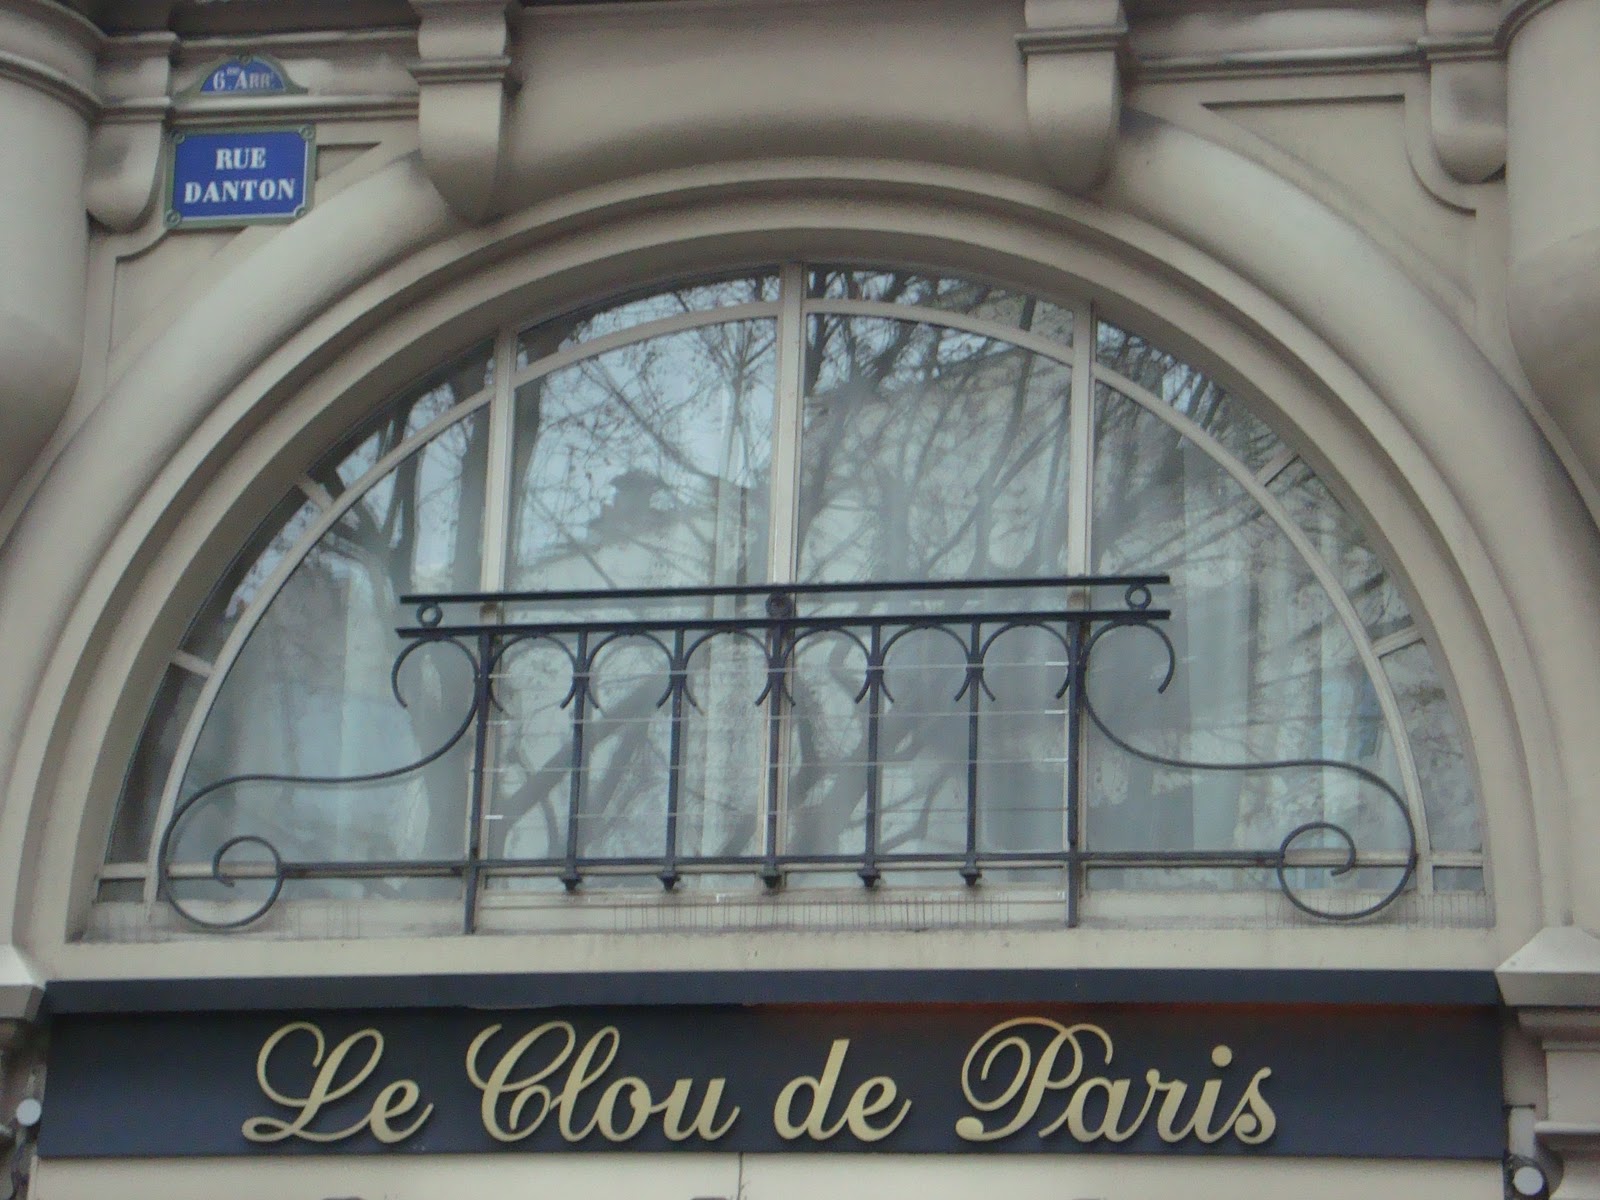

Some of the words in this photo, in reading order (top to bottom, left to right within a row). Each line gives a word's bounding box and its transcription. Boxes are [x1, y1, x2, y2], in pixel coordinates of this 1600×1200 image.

[216, 147, 266, 170] RUE
[184, 178, 295, 203] DANTON
[241, 1021, 434, 1143] Le
[466, 1020, 741, 1143] Clou
[774, 1038, 913, 1143] de
[955, 1016, 1277, 1146] Paris
